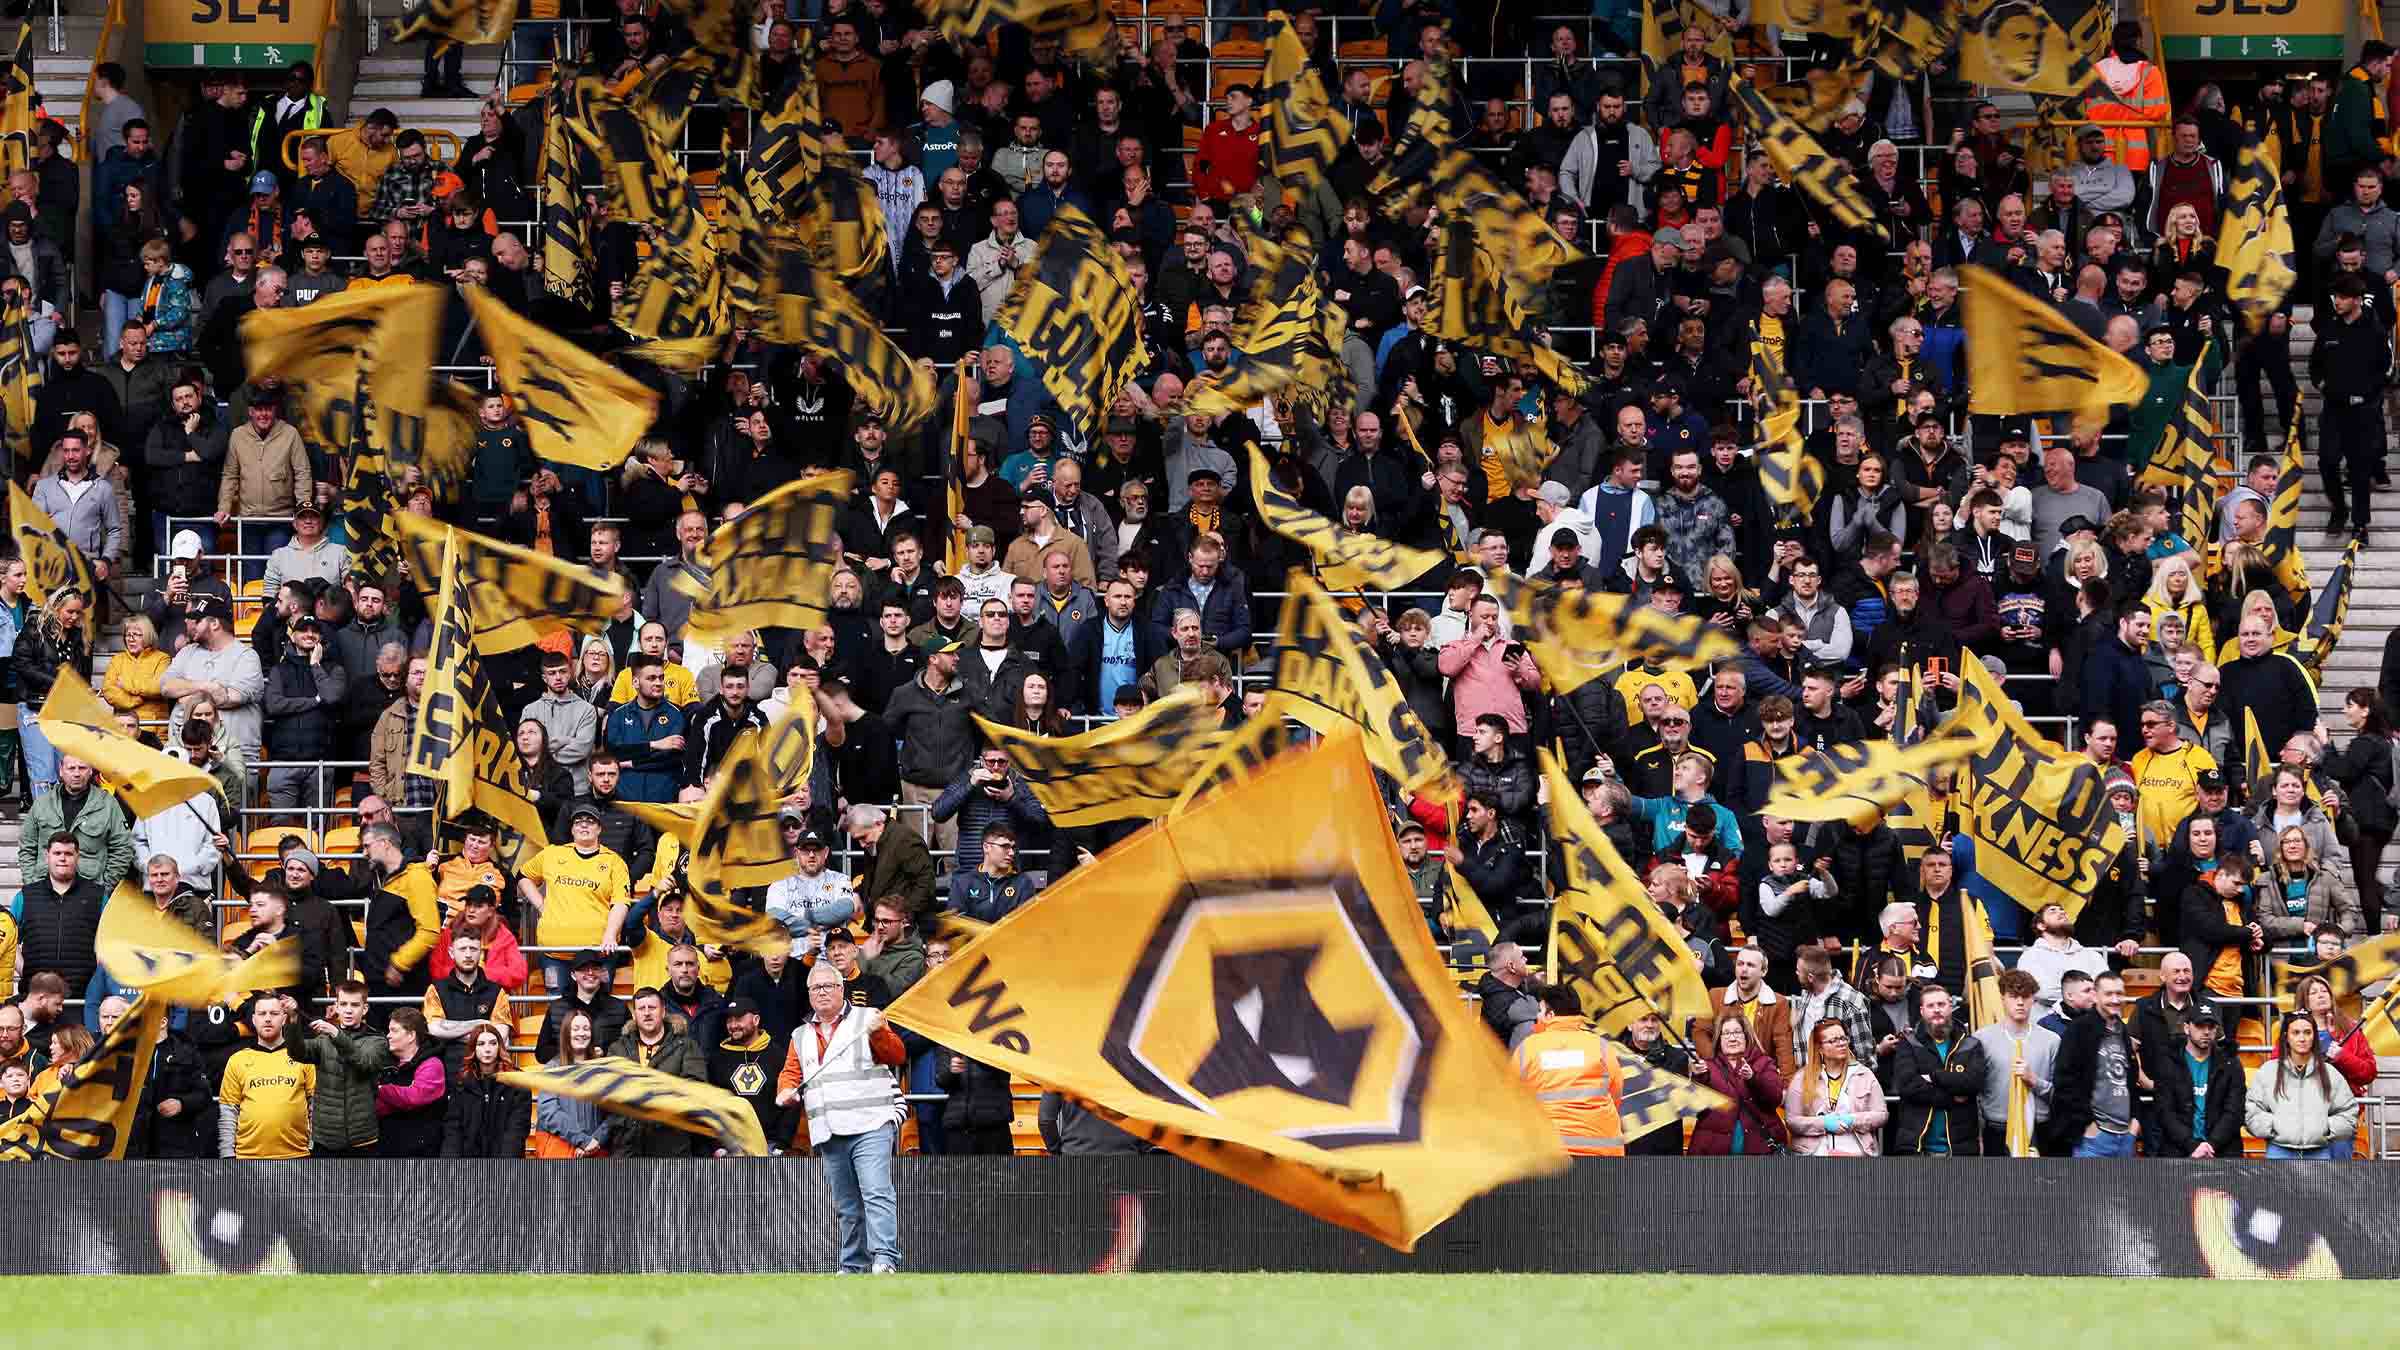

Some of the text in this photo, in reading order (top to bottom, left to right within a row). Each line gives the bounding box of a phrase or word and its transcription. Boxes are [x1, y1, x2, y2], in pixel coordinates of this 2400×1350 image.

[923, 142, 958, 152] AstroPa
[2139, 777, 2183, 791] AstroPay
[1973, 783, 2107, 893] KNESS
[554, 875, 601, 892] AstroPay
[947, 953, 1031, 1055] We
[249, 1076, 297, 1090] AstroPay
